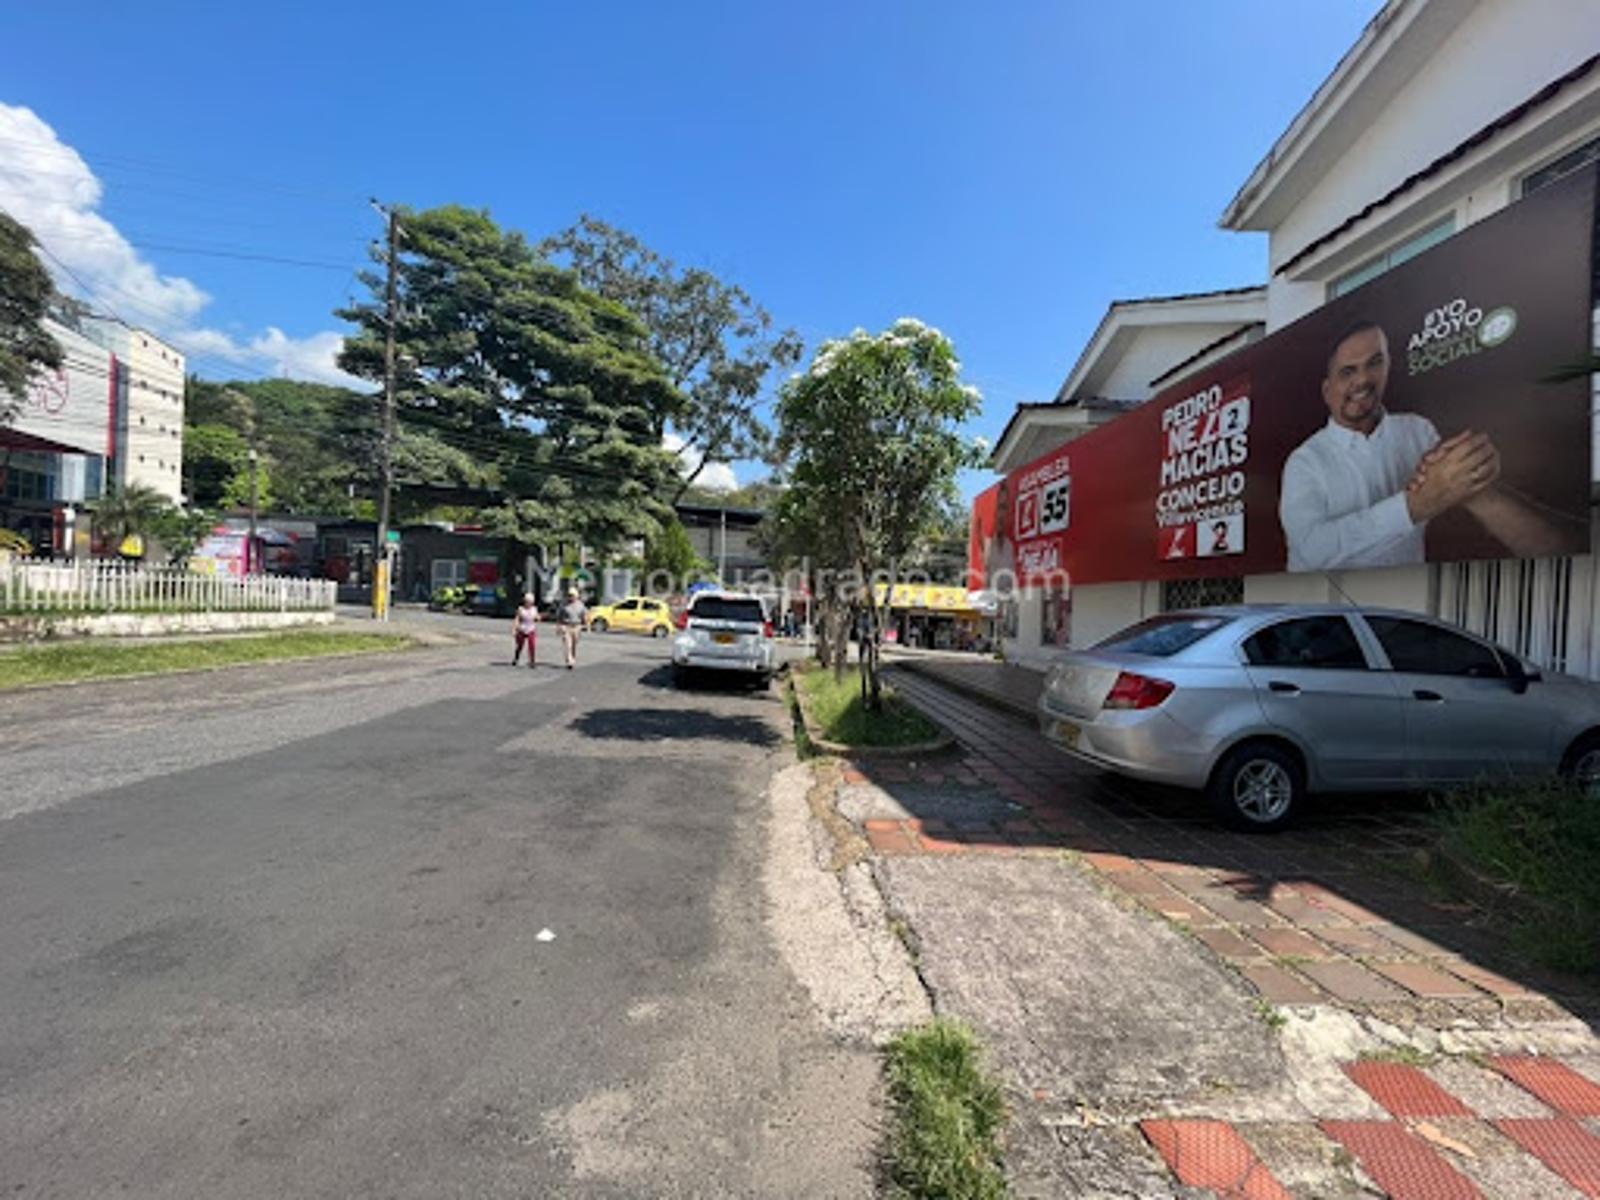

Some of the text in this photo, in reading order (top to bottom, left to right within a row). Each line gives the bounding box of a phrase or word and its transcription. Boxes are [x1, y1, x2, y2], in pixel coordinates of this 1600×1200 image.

[1408, 308, 1482, 350] APOYO
[1162, 384, 1222, 431] PEDRO
[1162, 432, 1248, 487] MACIAS
[1043, 486, 1067, 525] 55
[1158, 471, 1245, 513] CONCEJO
